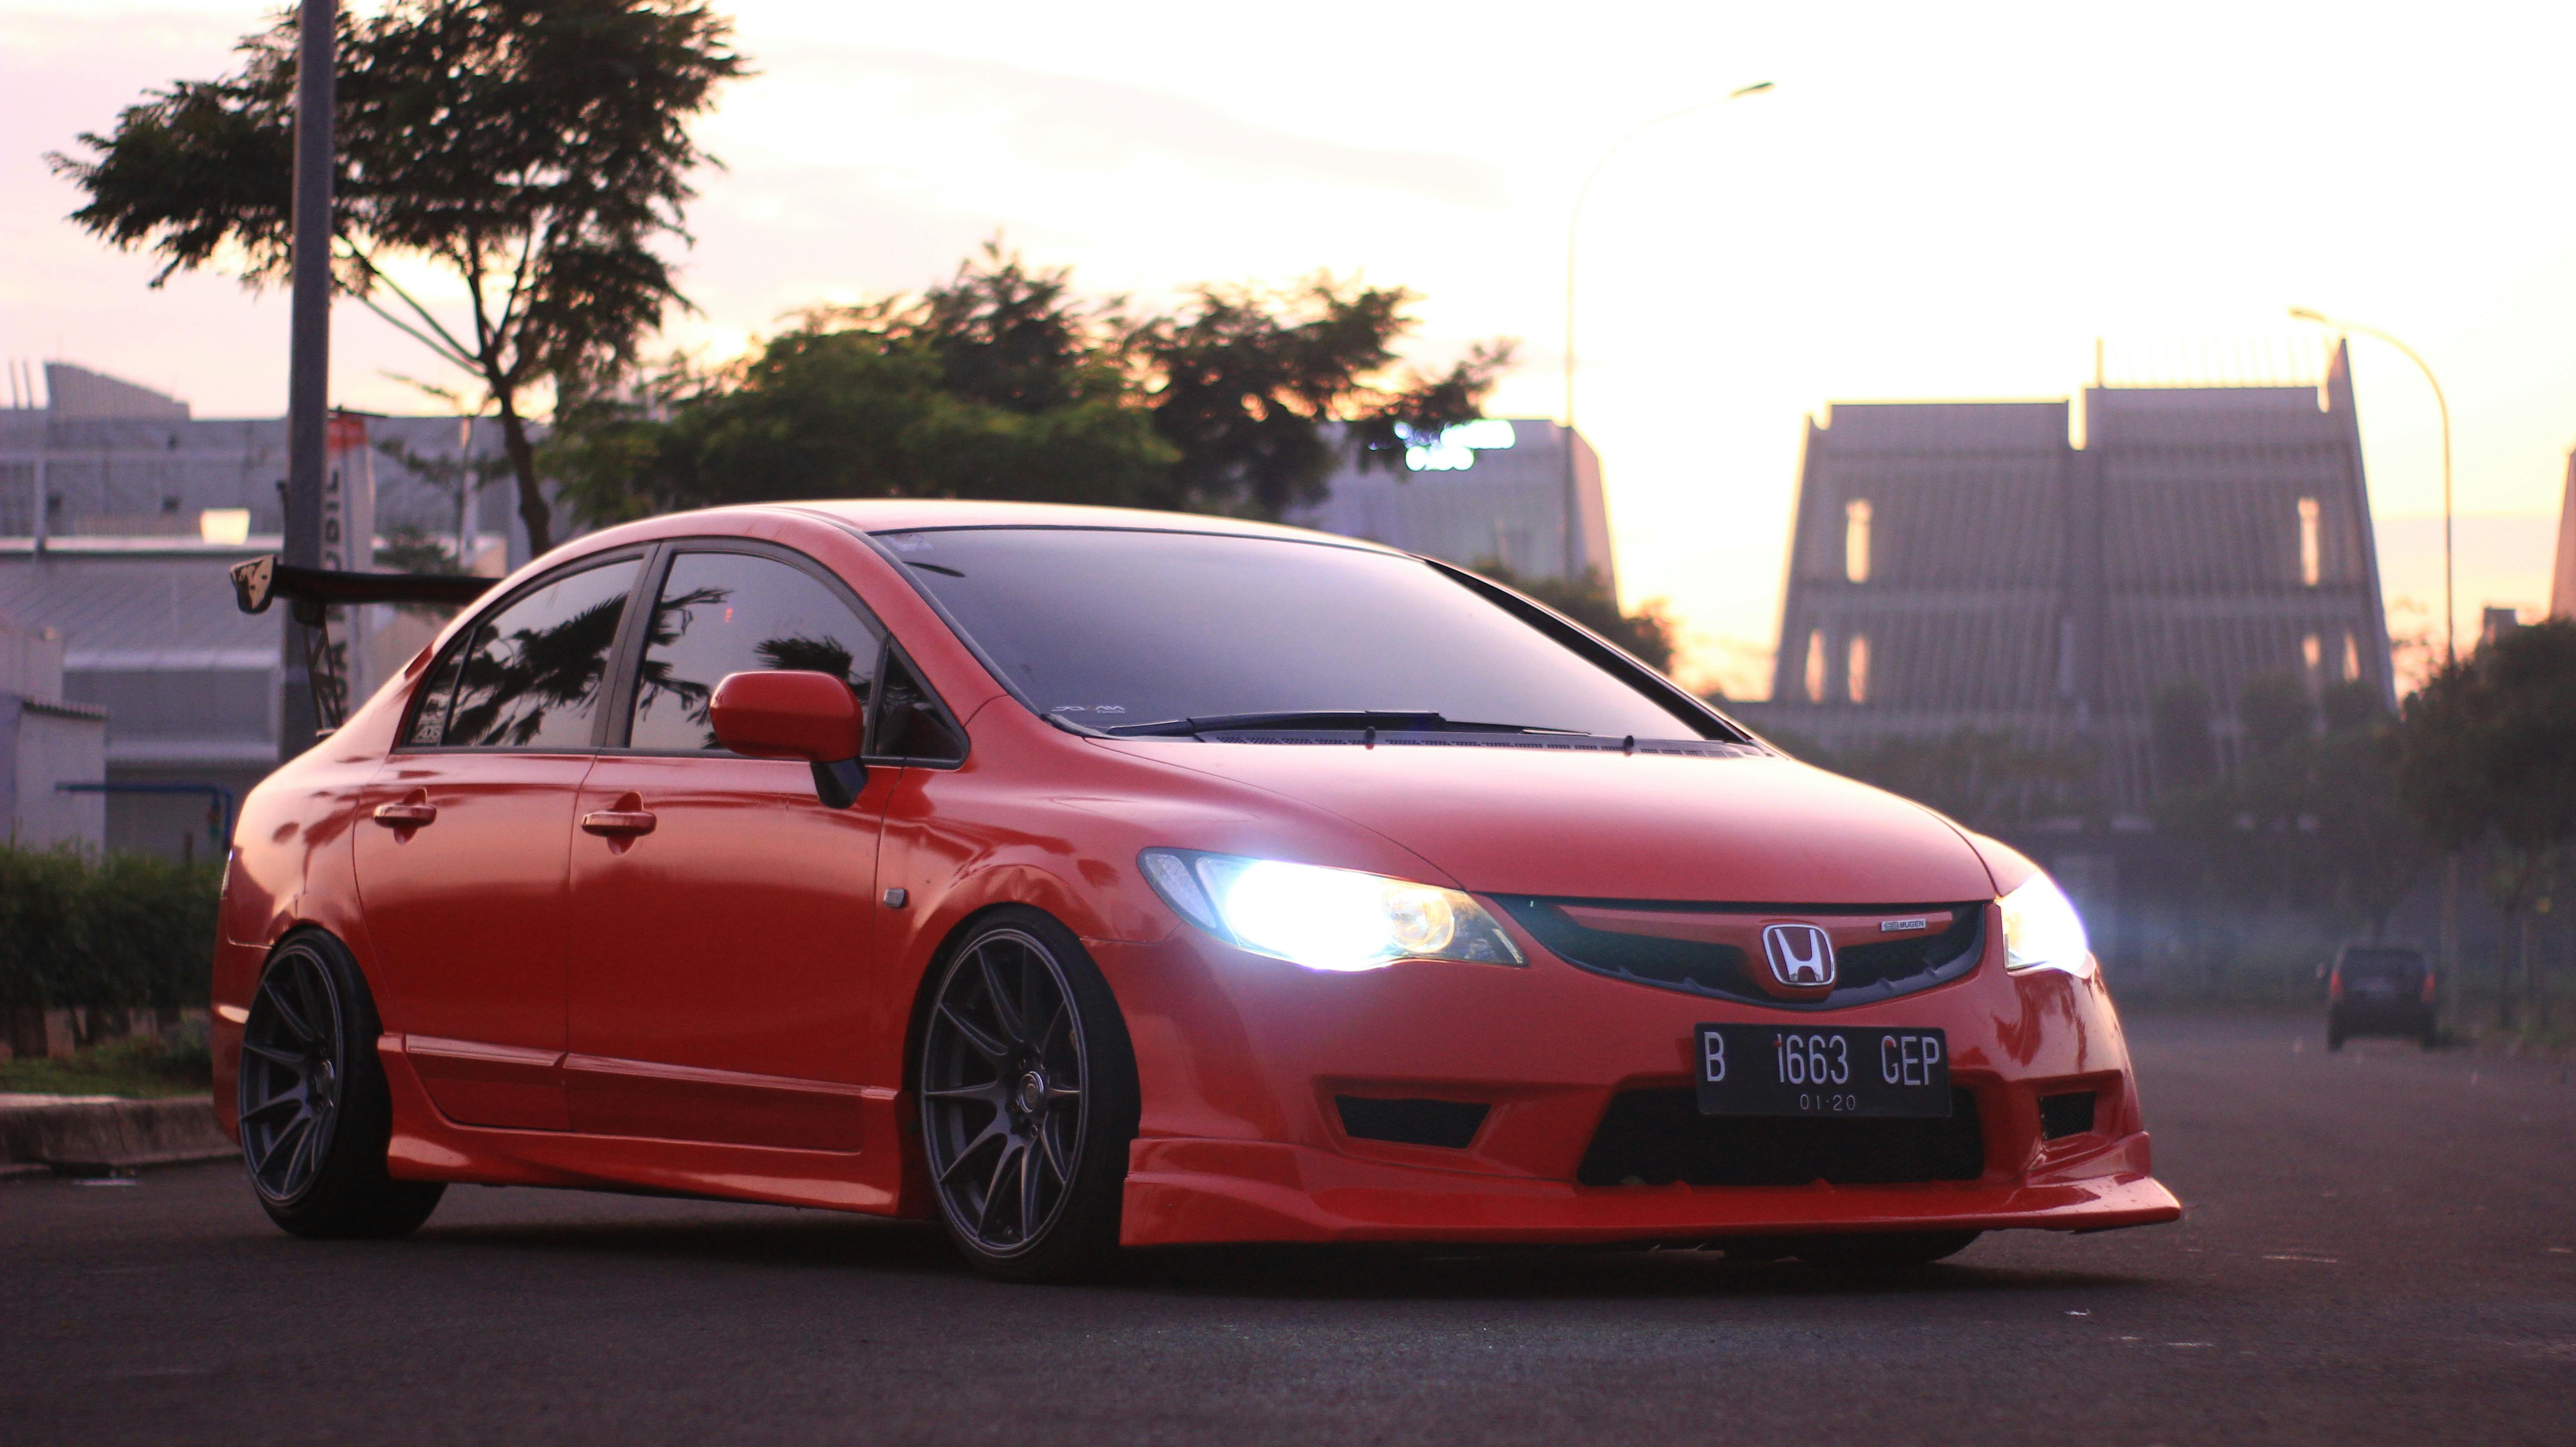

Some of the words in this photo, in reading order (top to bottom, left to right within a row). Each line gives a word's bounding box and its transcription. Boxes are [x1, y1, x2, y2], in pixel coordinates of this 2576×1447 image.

[1704, 1031, 1726, 1082] B
[1776, 1033, 1849, 1085] 1663
[1881, 1035, 1939, 1086] GEP
